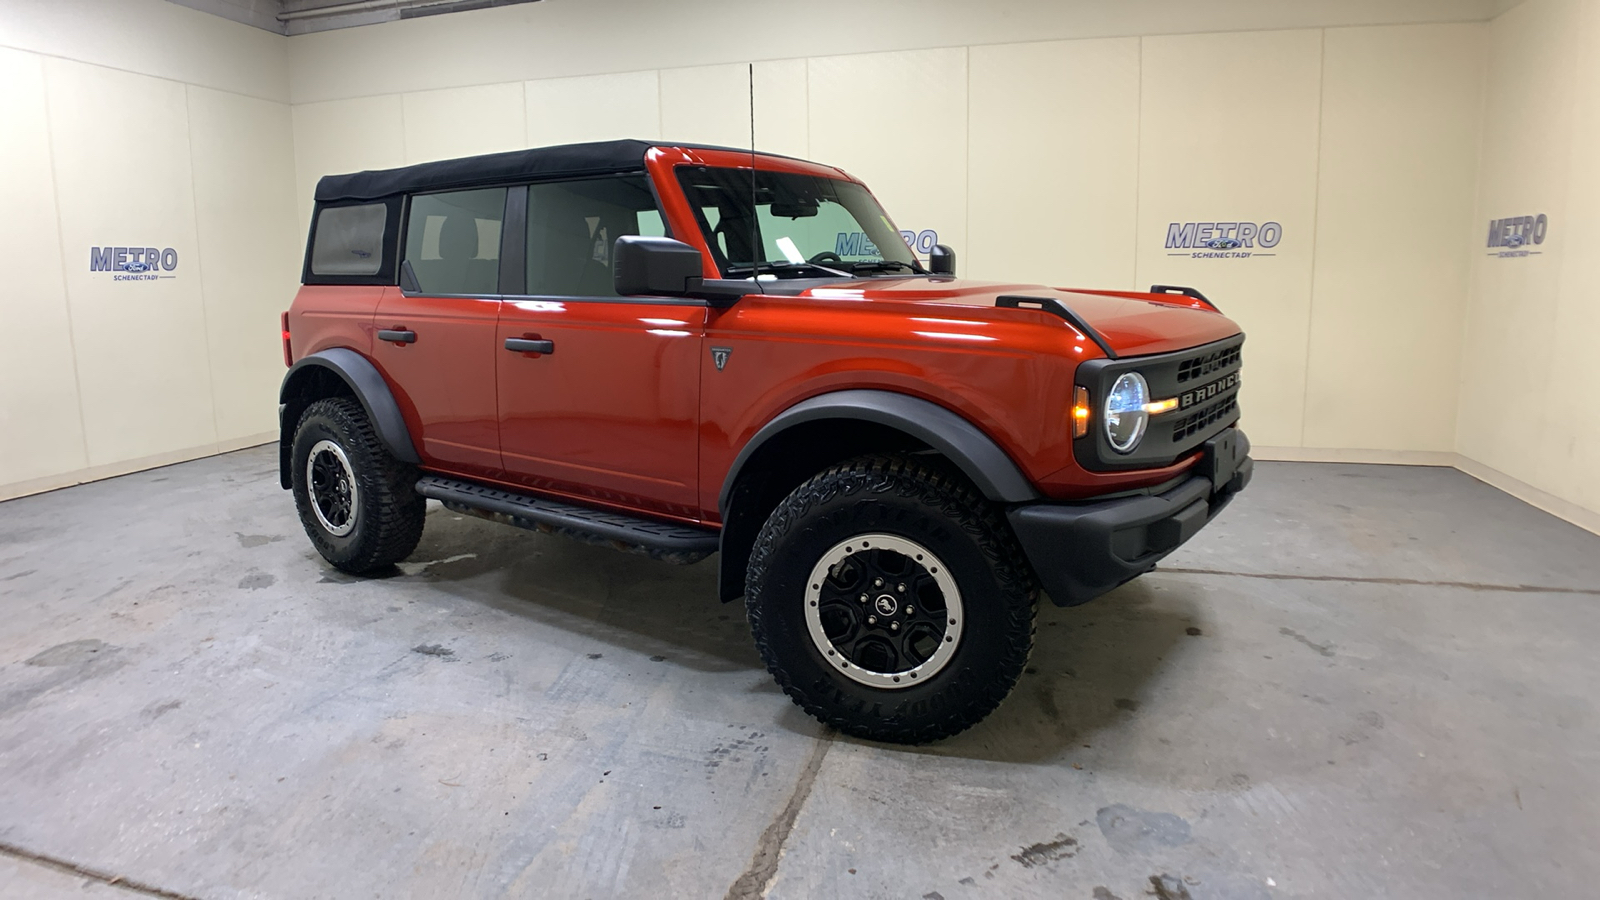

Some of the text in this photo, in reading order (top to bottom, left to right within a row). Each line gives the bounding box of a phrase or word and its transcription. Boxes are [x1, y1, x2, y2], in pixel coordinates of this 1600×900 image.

[834, 229, 938, 256] MEO
[1165, 222, 1282, 248] METRO
[1487, 213, 1547, 248] METRO
[90, 247, 178, 271] METRO
